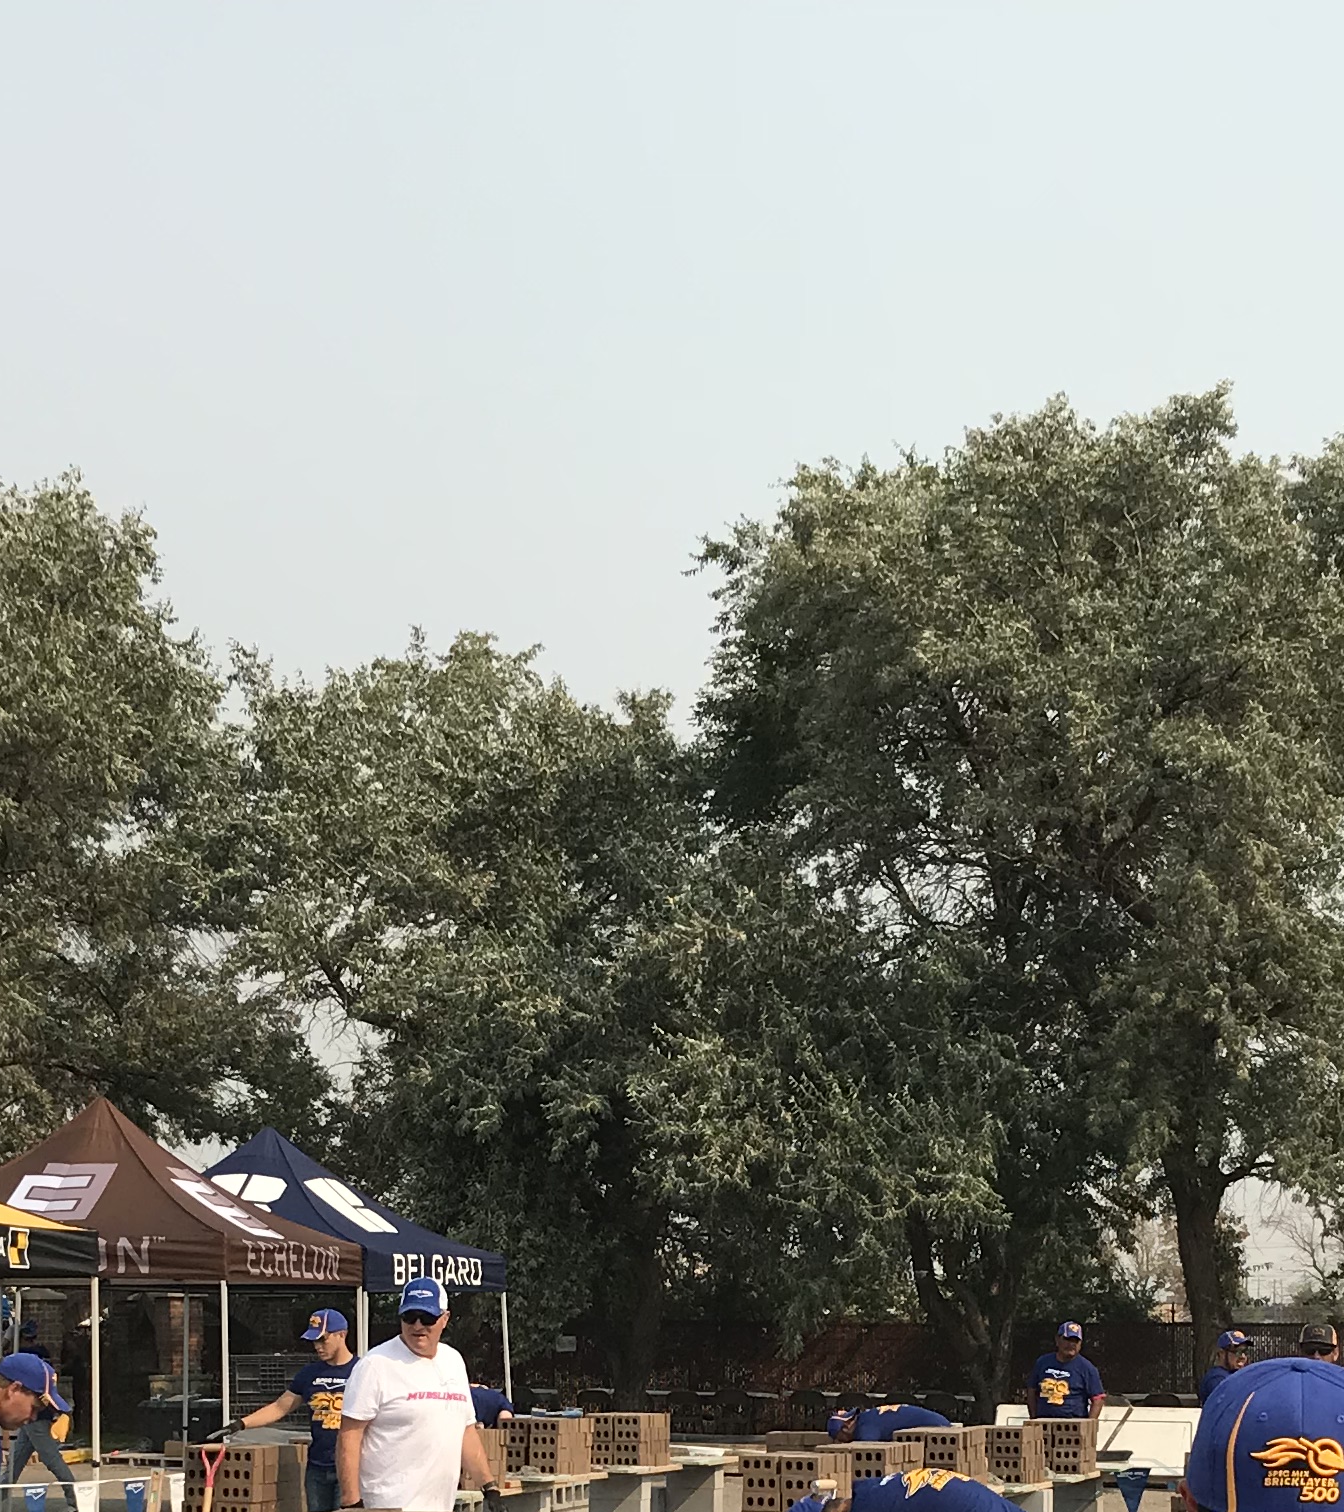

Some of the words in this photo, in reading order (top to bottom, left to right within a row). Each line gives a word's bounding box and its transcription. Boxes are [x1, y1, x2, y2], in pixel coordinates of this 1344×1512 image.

[242, 1238, 341, 1282] ECHELON
[1267, 1469, 1290, 1478] SPEC
[1291, 1469, 1310, 1478] MIX
[1264, 1477, 1336, 1488] BRICKLAYER
[1299, 1486, 1340, 1503] 500
